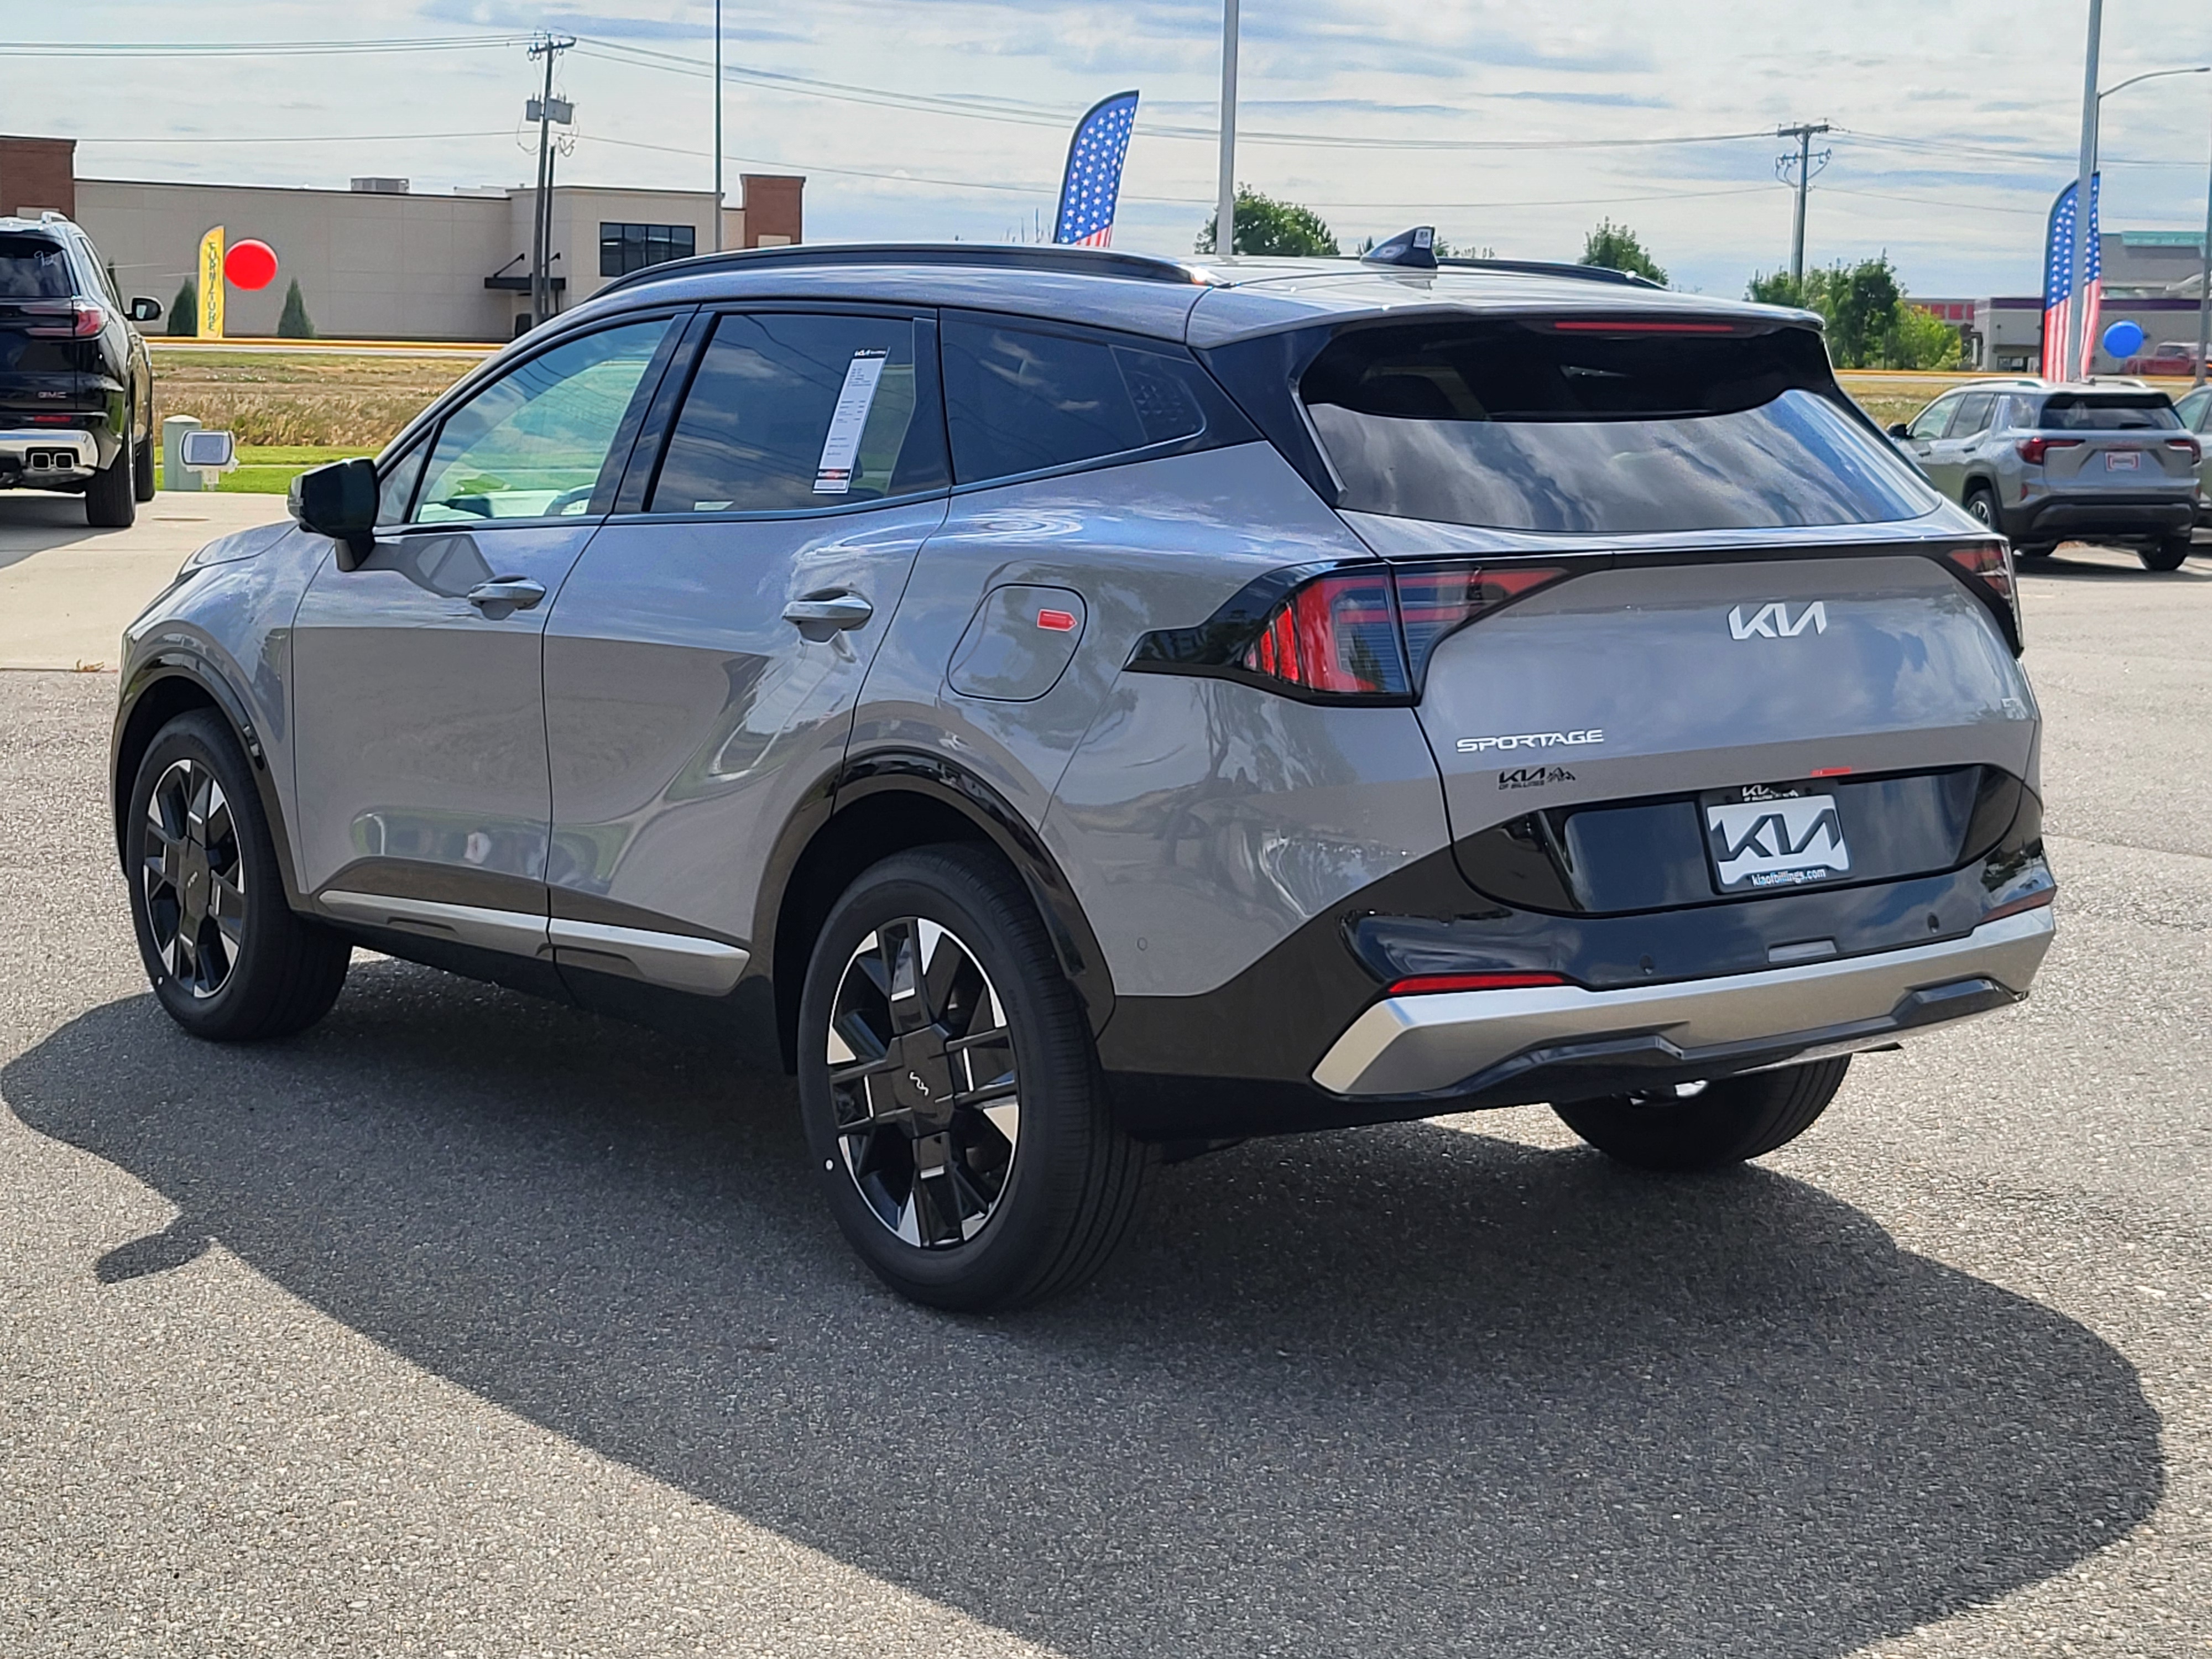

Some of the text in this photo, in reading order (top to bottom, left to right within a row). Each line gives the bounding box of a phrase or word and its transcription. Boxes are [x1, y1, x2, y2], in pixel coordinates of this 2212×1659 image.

[208, 242, 217, 331] FURNITURE
[1728, 601, 1827, 639] KIA
[1456, 728, 1604, 753] SPORTAGE
[1499, 767, 1545, 784] KIA
[1710, 808, 1841, 862] KIA
